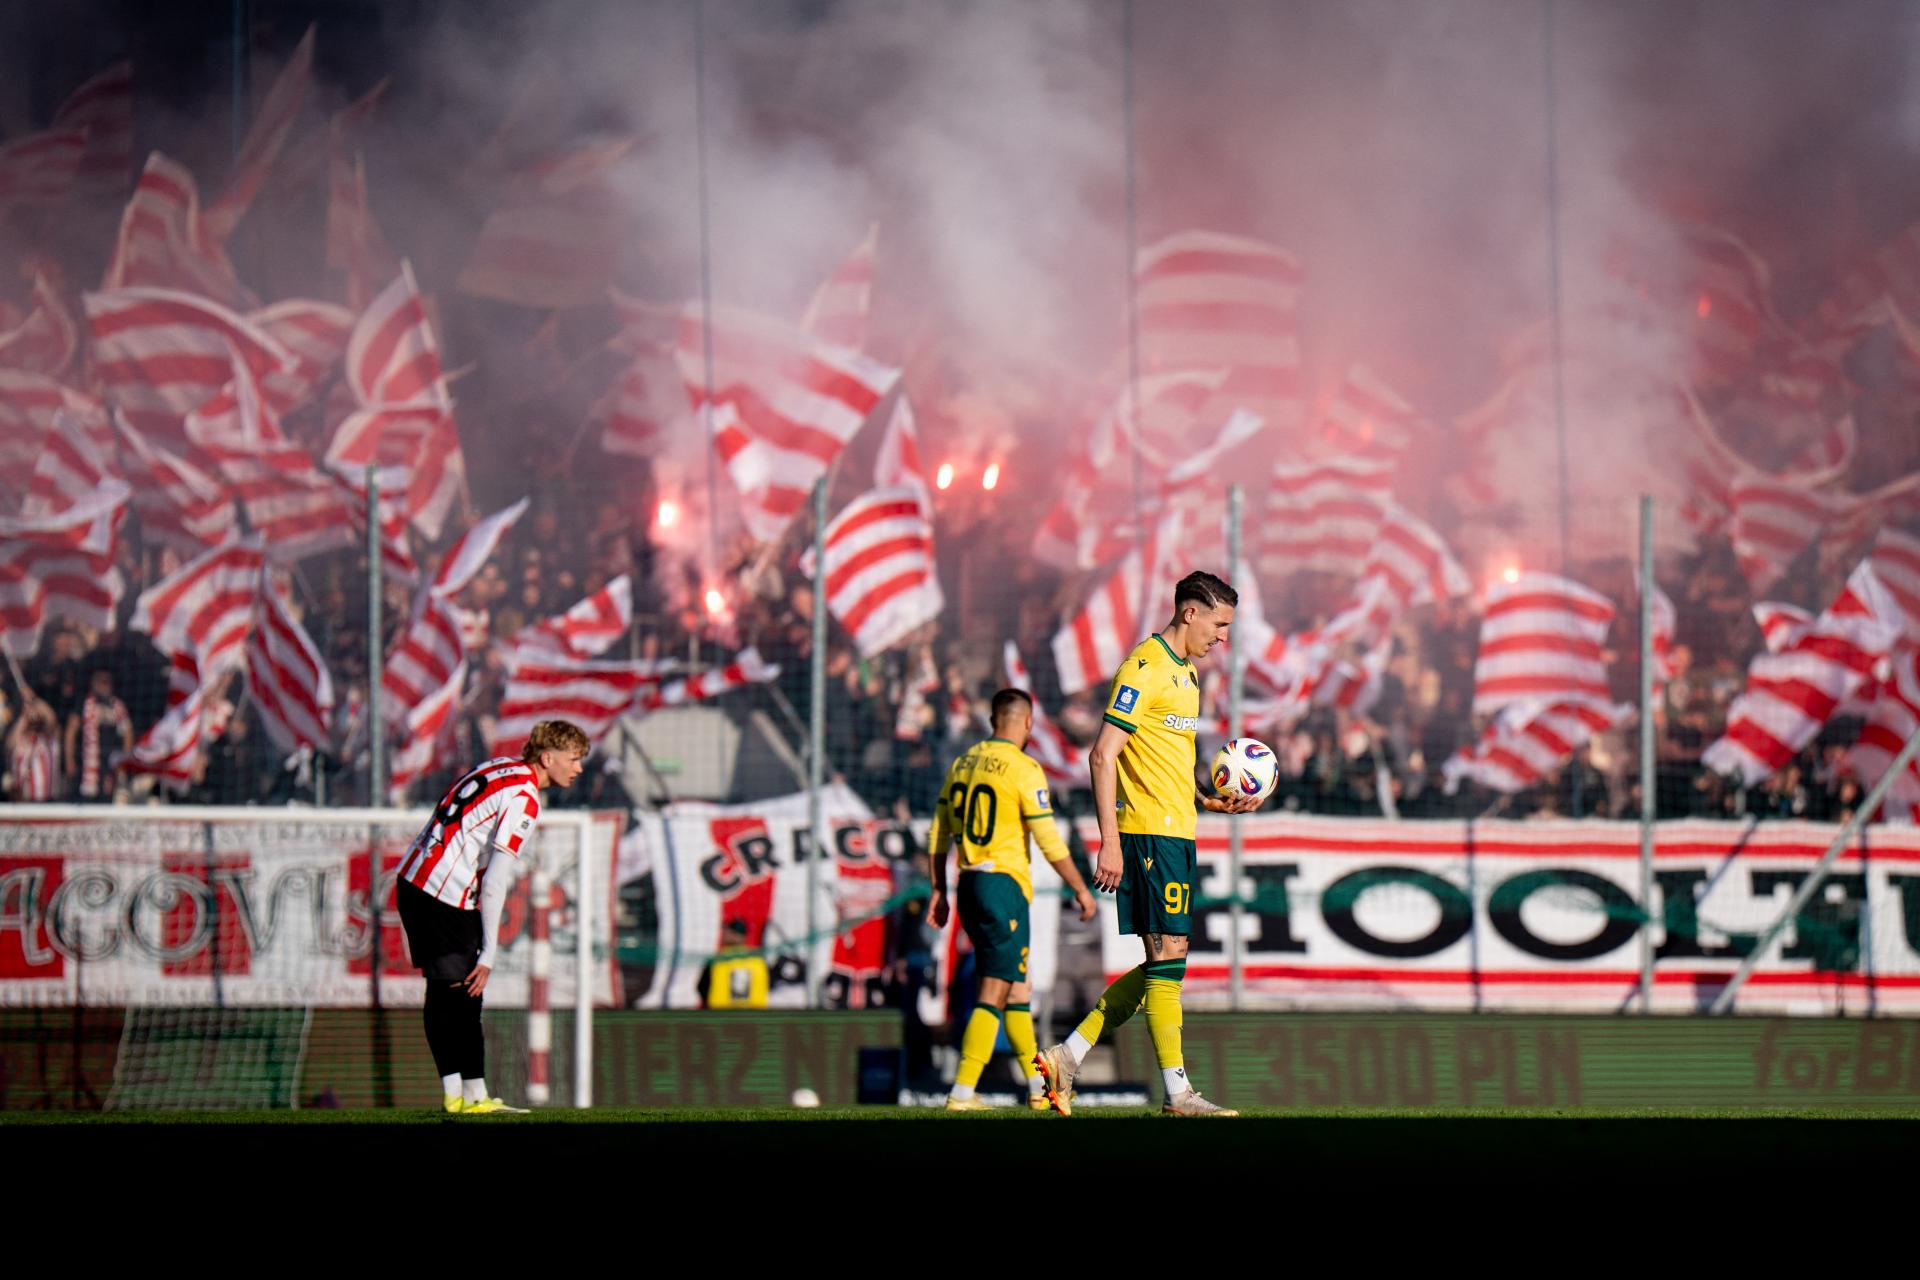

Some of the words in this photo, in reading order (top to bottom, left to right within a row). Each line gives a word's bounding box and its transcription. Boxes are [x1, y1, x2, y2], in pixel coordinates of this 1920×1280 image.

[436, 773, 488, 827] 8
[949, 782, 997, 847] 30
[1165, 882, 1189, 915] 97
[1252, 1024, 1432, 1105] 3500
[1457, 1024, 1582, 1105] PLN
